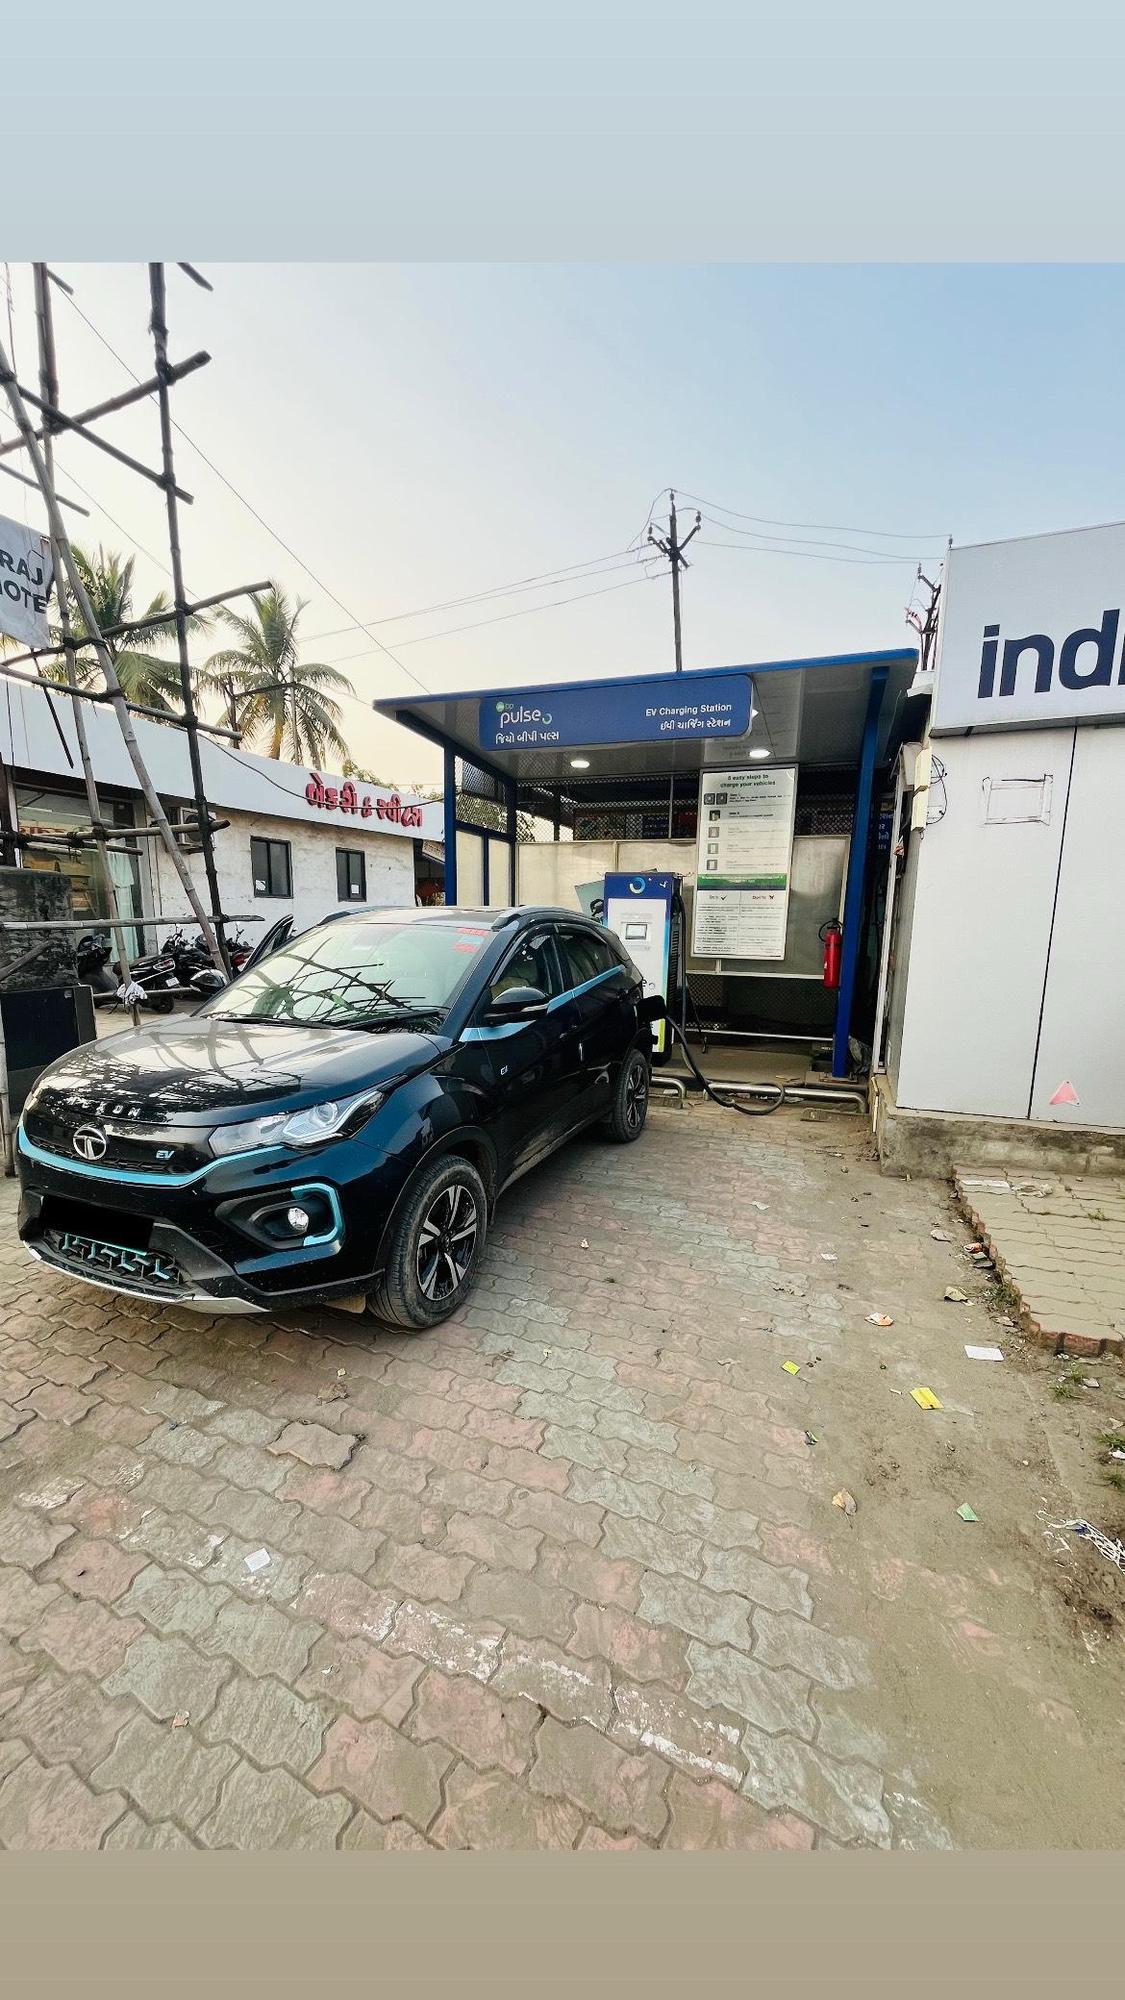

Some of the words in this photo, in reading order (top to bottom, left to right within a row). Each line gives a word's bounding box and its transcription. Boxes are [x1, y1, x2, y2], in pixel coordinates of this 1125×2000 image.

[0, 579, 48, 614] OTE
[500, 705, 541, 729] pulse
[645, 708, 658, 717] EV
[659, 705, 698, 716] Charging
[700, 702, 732, 713] Station
[155, 1150, 175, 1159] EV
